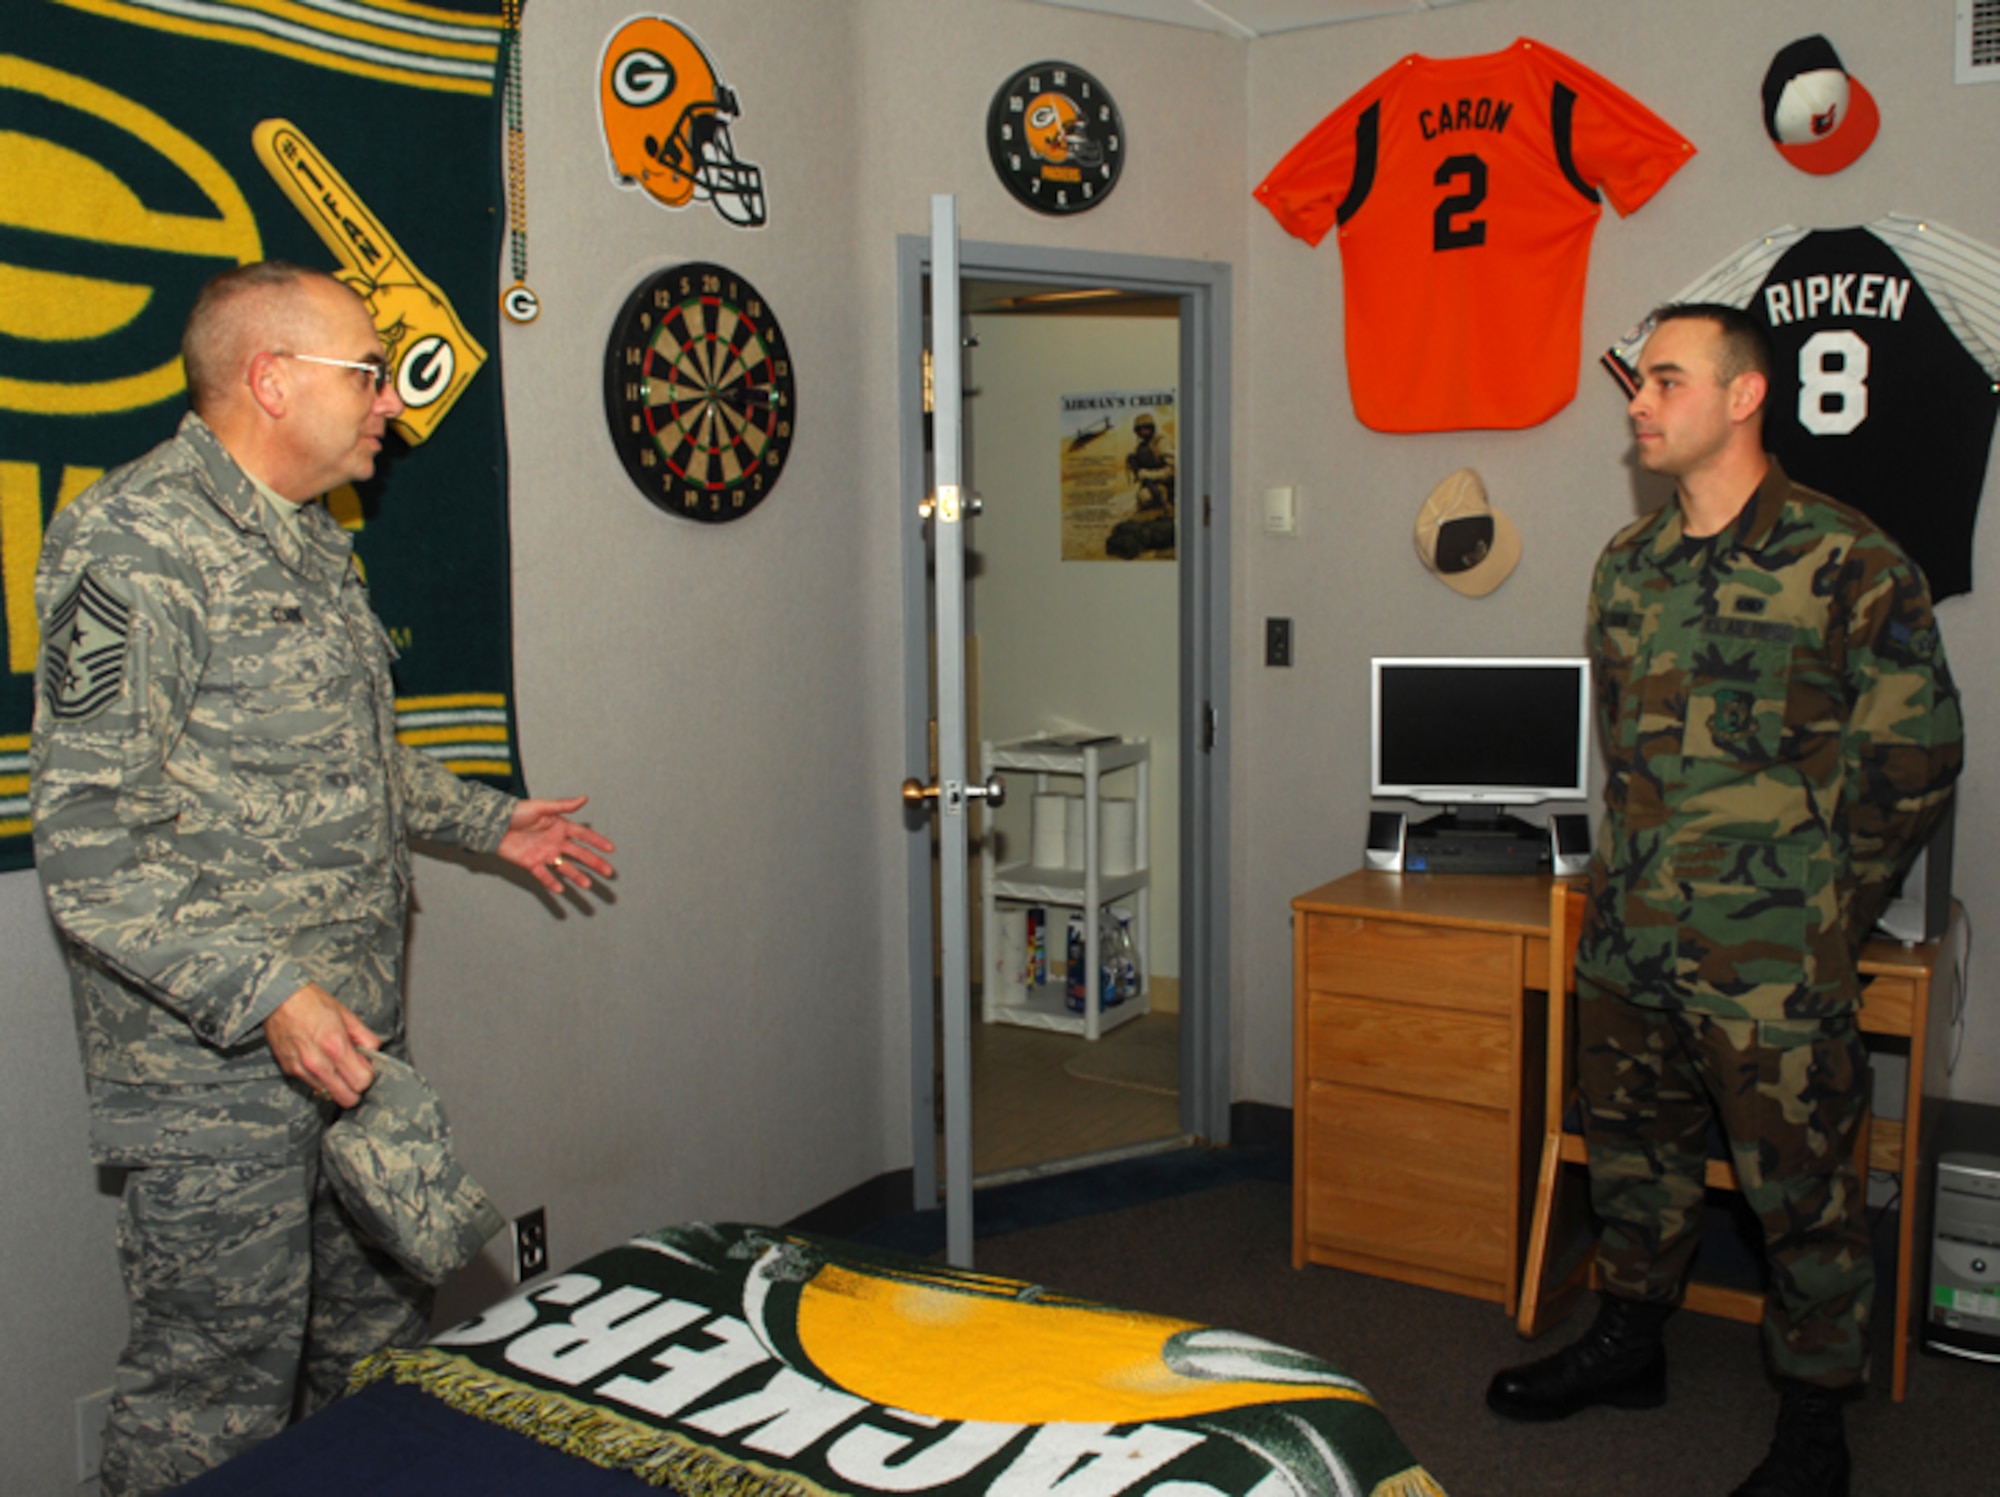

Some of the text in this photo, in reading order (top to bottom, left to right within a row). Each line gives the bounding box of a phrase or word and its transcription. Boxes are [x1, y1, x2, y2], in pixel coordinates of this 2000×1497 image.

[614, 51, 671, 105] G
[1419, 97, 1514, 140] CARON
[321, 190, 382, 267] FAN
[1433, 152, 1488, 253] 2
[502, 286, 540, 322] G
[1764, 273, 1911, 327] RIPKEN
[397, 336, 455, 407] G
[1798, 329, 1870, 436] 8
[1063, 394, 1174, 411] AIRMAN'S CREED
